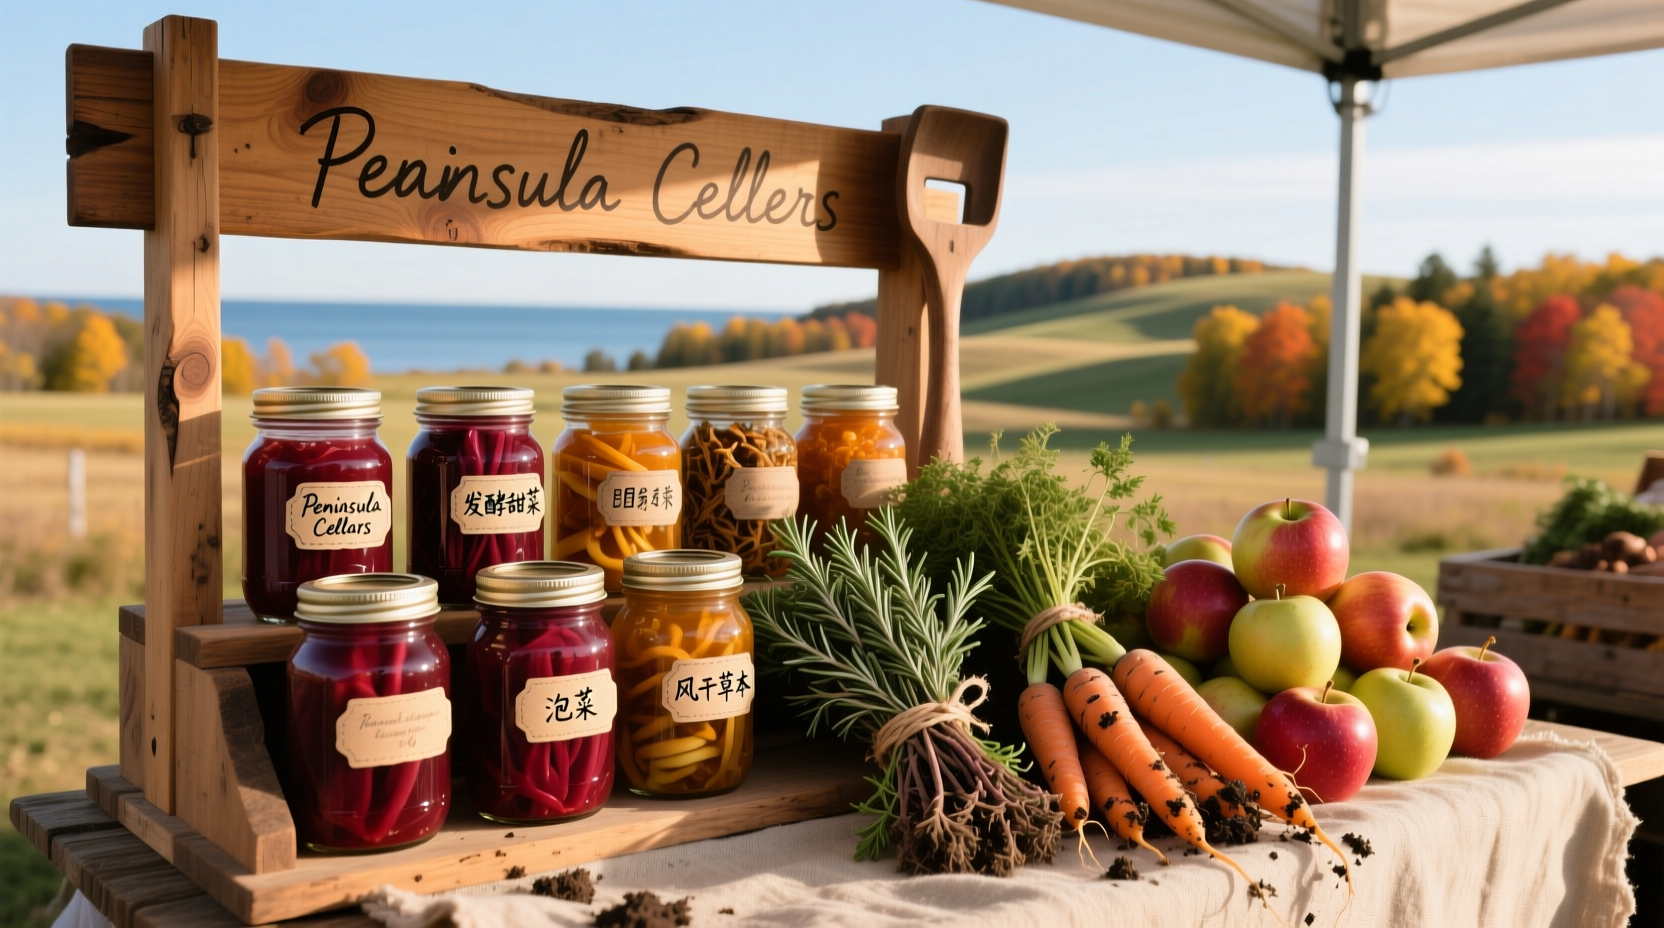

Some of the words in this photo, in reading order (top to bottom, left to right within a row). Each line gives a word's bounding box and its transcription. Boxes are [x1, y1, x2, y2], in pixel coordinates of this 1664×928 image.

[652, 142, 839, 231] Cellers
[301, 491, 382, 518] Peninsula
[464, 487, 541, 517] 发酵甜菜
[313, 516, 371, 537] Cellars
[674, 670, 751, 702] 风干草本
[545, 686, 598, 724] 泡菜
